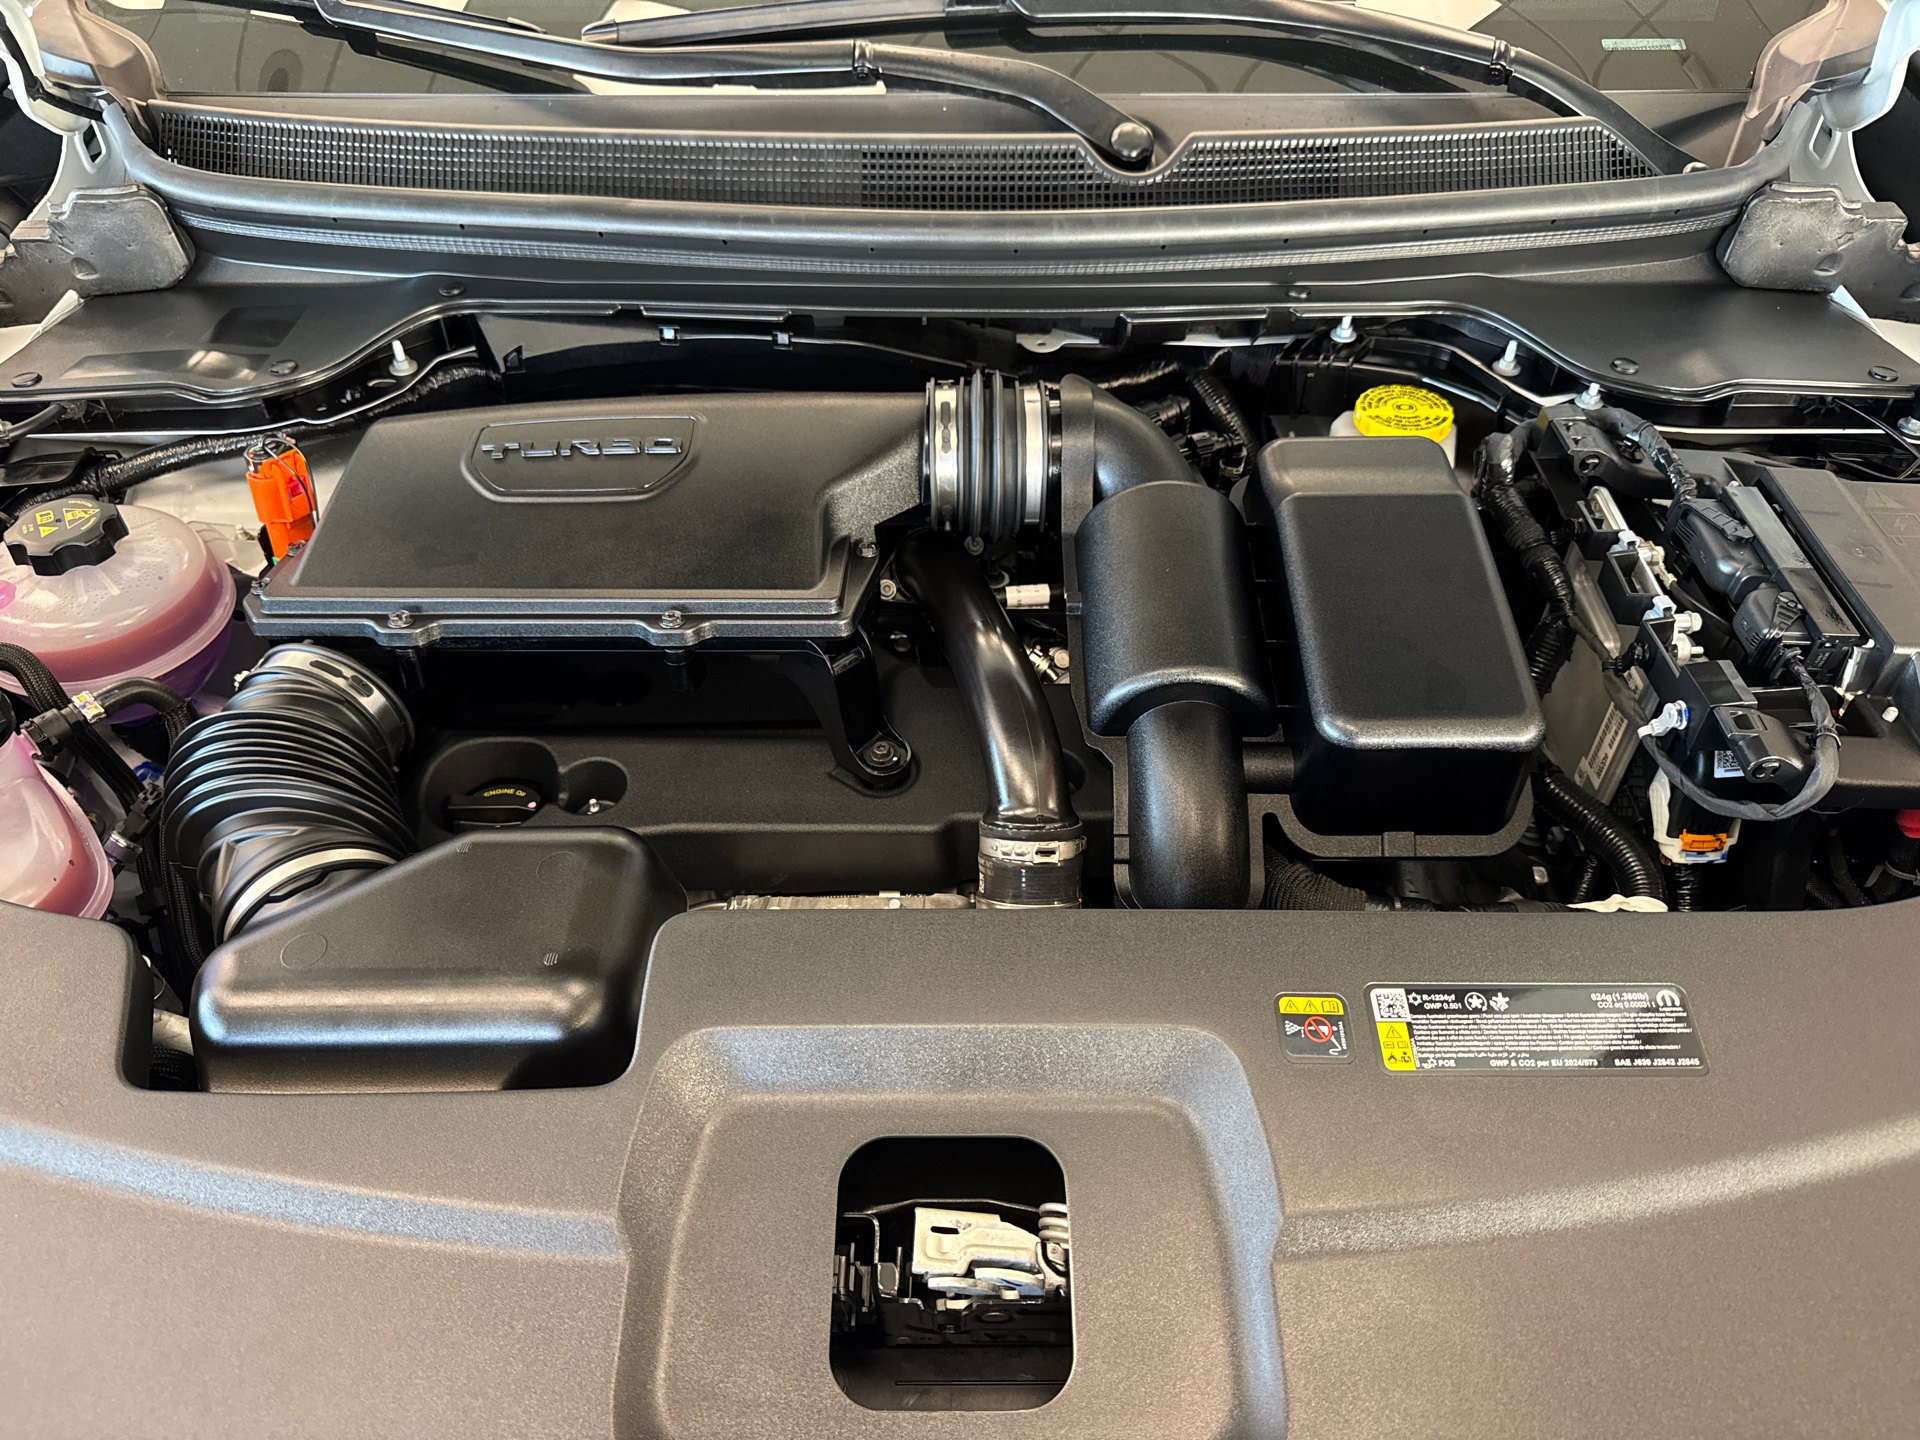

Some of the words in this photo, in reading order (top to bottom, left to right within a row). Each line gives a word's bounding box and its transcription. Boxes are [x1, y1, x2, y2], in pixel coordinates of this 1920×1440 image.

[481, 437, 683, 459] TURBO
[484, 788, 515, 797] ENGINE
[1423, 1002, 1442, 1010] GWP
[1442, 1002, 1462, 1010] 0.501
[1597, 1001, 1613, 1009] CO2
[1438, 1059, 1457, 1067] POE
[1489, 1059, 1509, 1067] GWP
[1510, 1059, 1517, 1067] &
[1518, 1059, 1536, 1067] CO2
[1536, 1060, 1549, 1068] per
[1551, 1059, 1563, 1067] EU
[1614, 1058, 1632, 1067] SAE
